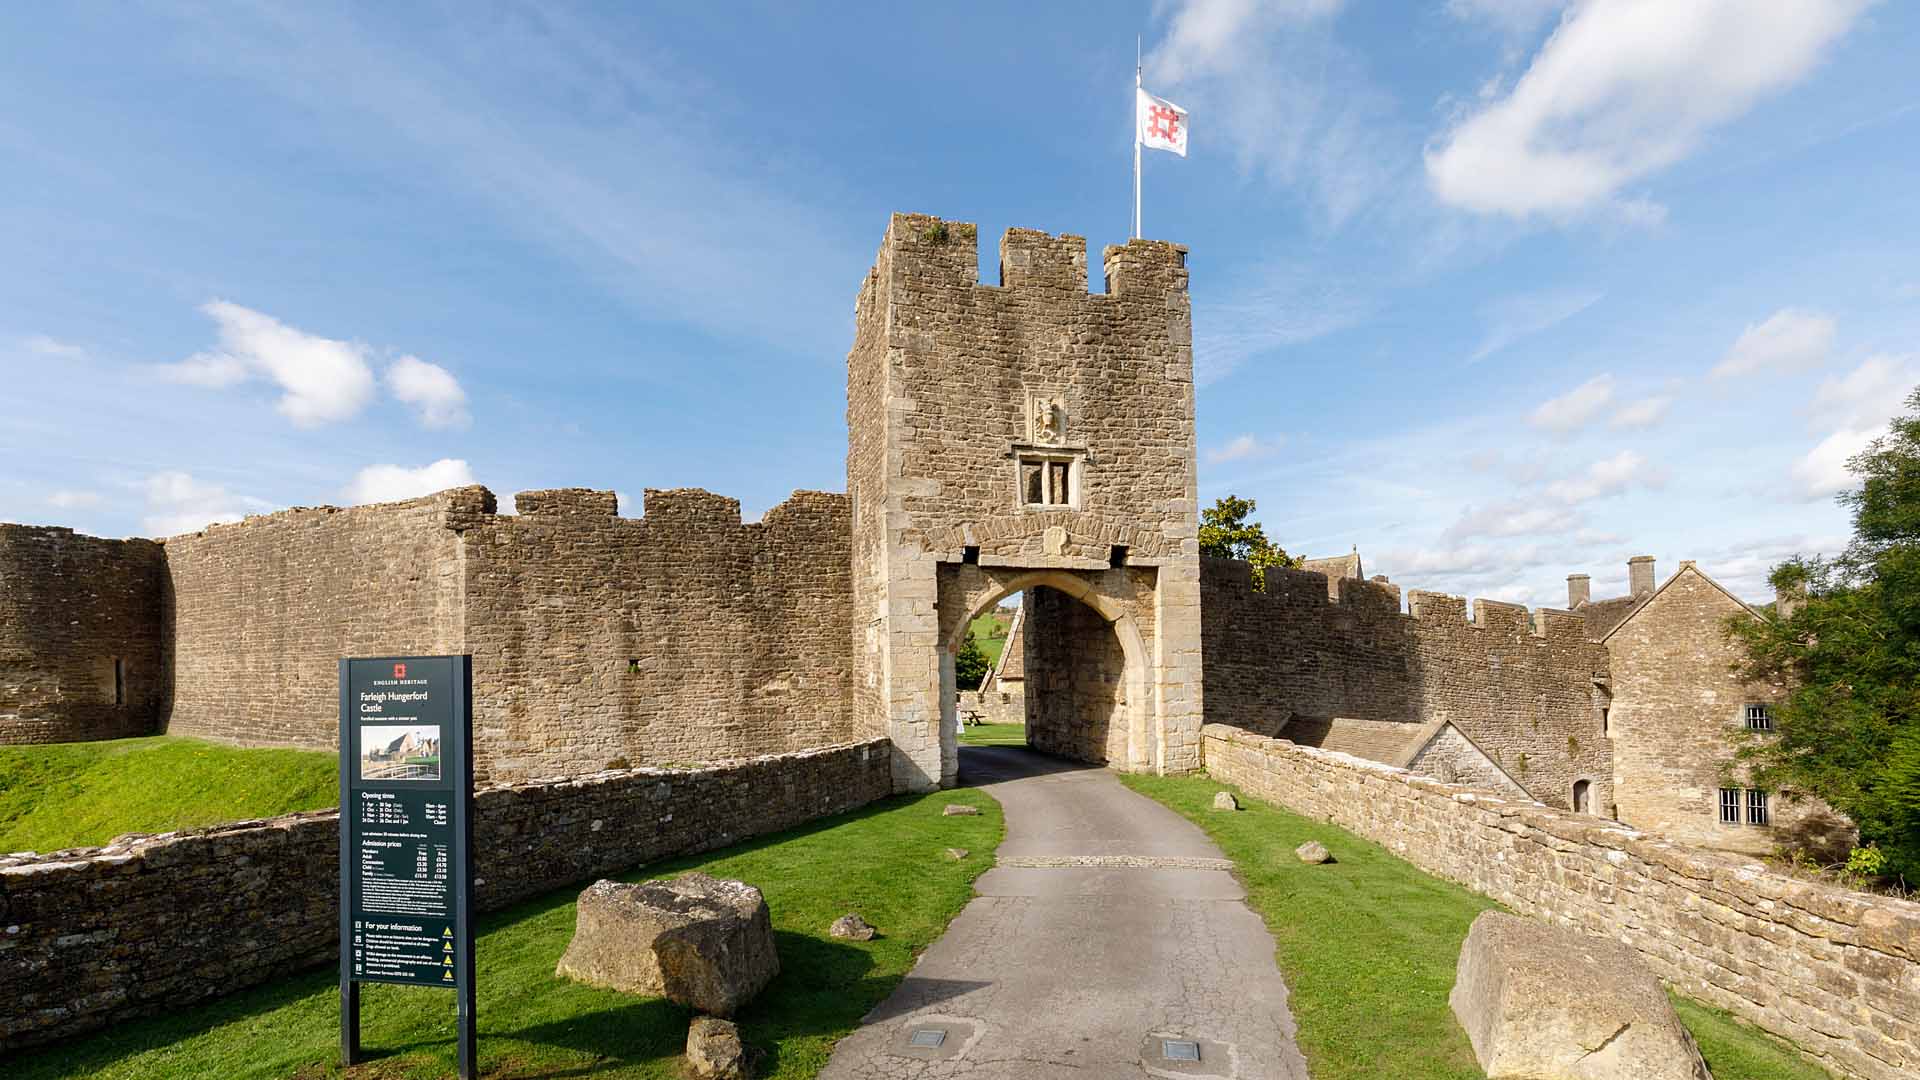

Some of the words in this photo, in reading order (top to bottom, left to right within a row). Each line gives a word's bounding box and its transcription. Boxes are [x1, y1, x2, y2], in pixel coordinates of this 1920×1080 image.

[360, 692, 387, 703] Farleigh
[388, 691, 428, 702] Hungerford
[360, 703, 382, 713] Castle
[362, 792, 381, 800] Opening
[390, 923, 422, 932] information
